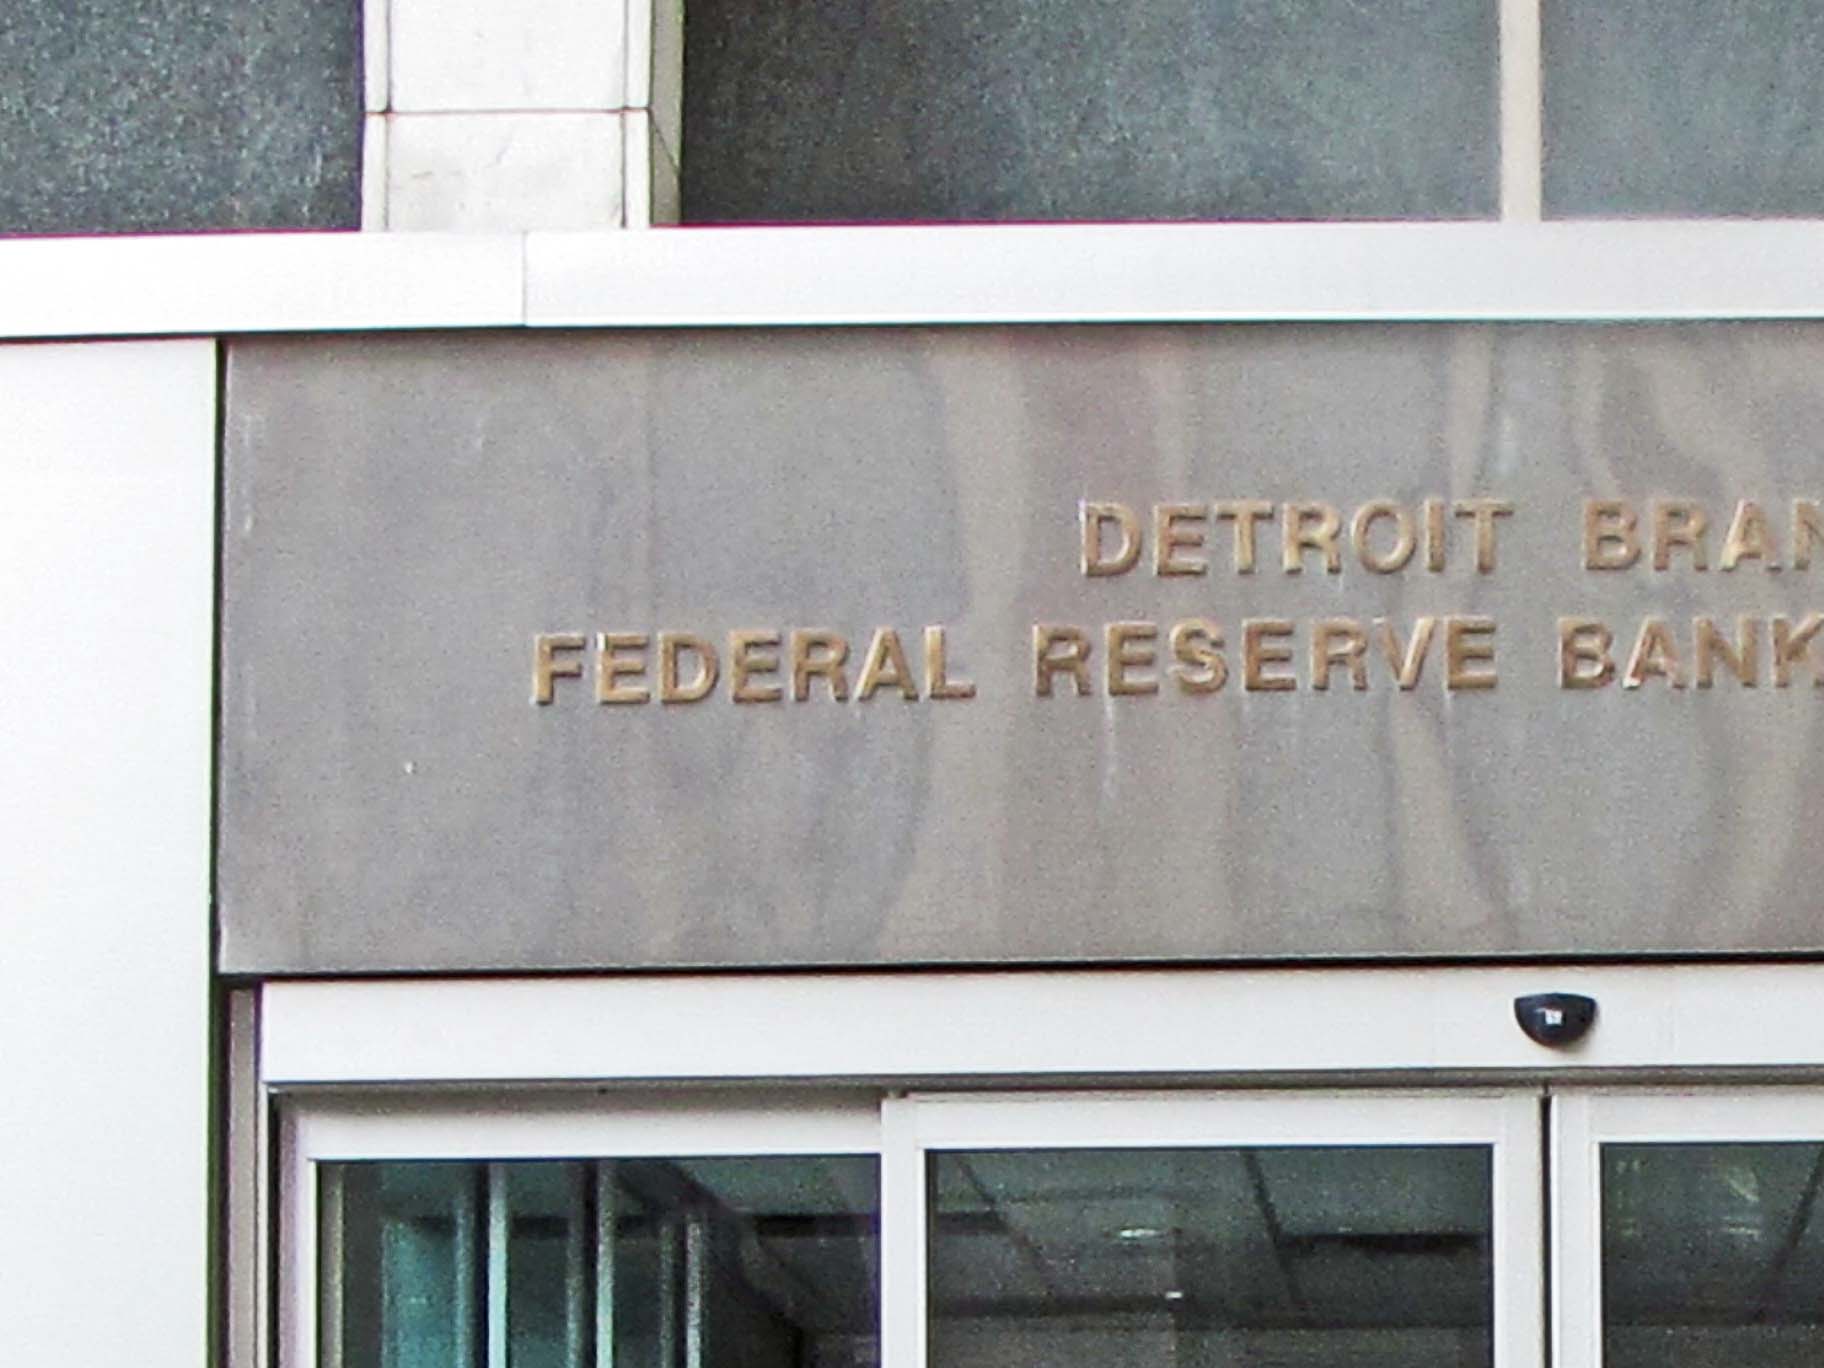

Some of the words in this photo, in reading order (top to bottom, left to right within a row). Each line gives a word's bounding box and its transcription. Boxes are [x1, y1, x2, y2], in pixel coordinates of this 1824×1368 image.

[1080, 497, 1513, 577] DETROIT
[531, 622, 976, 706] FEDERAL
[1031, 615, 1498, 699] RESERVE
